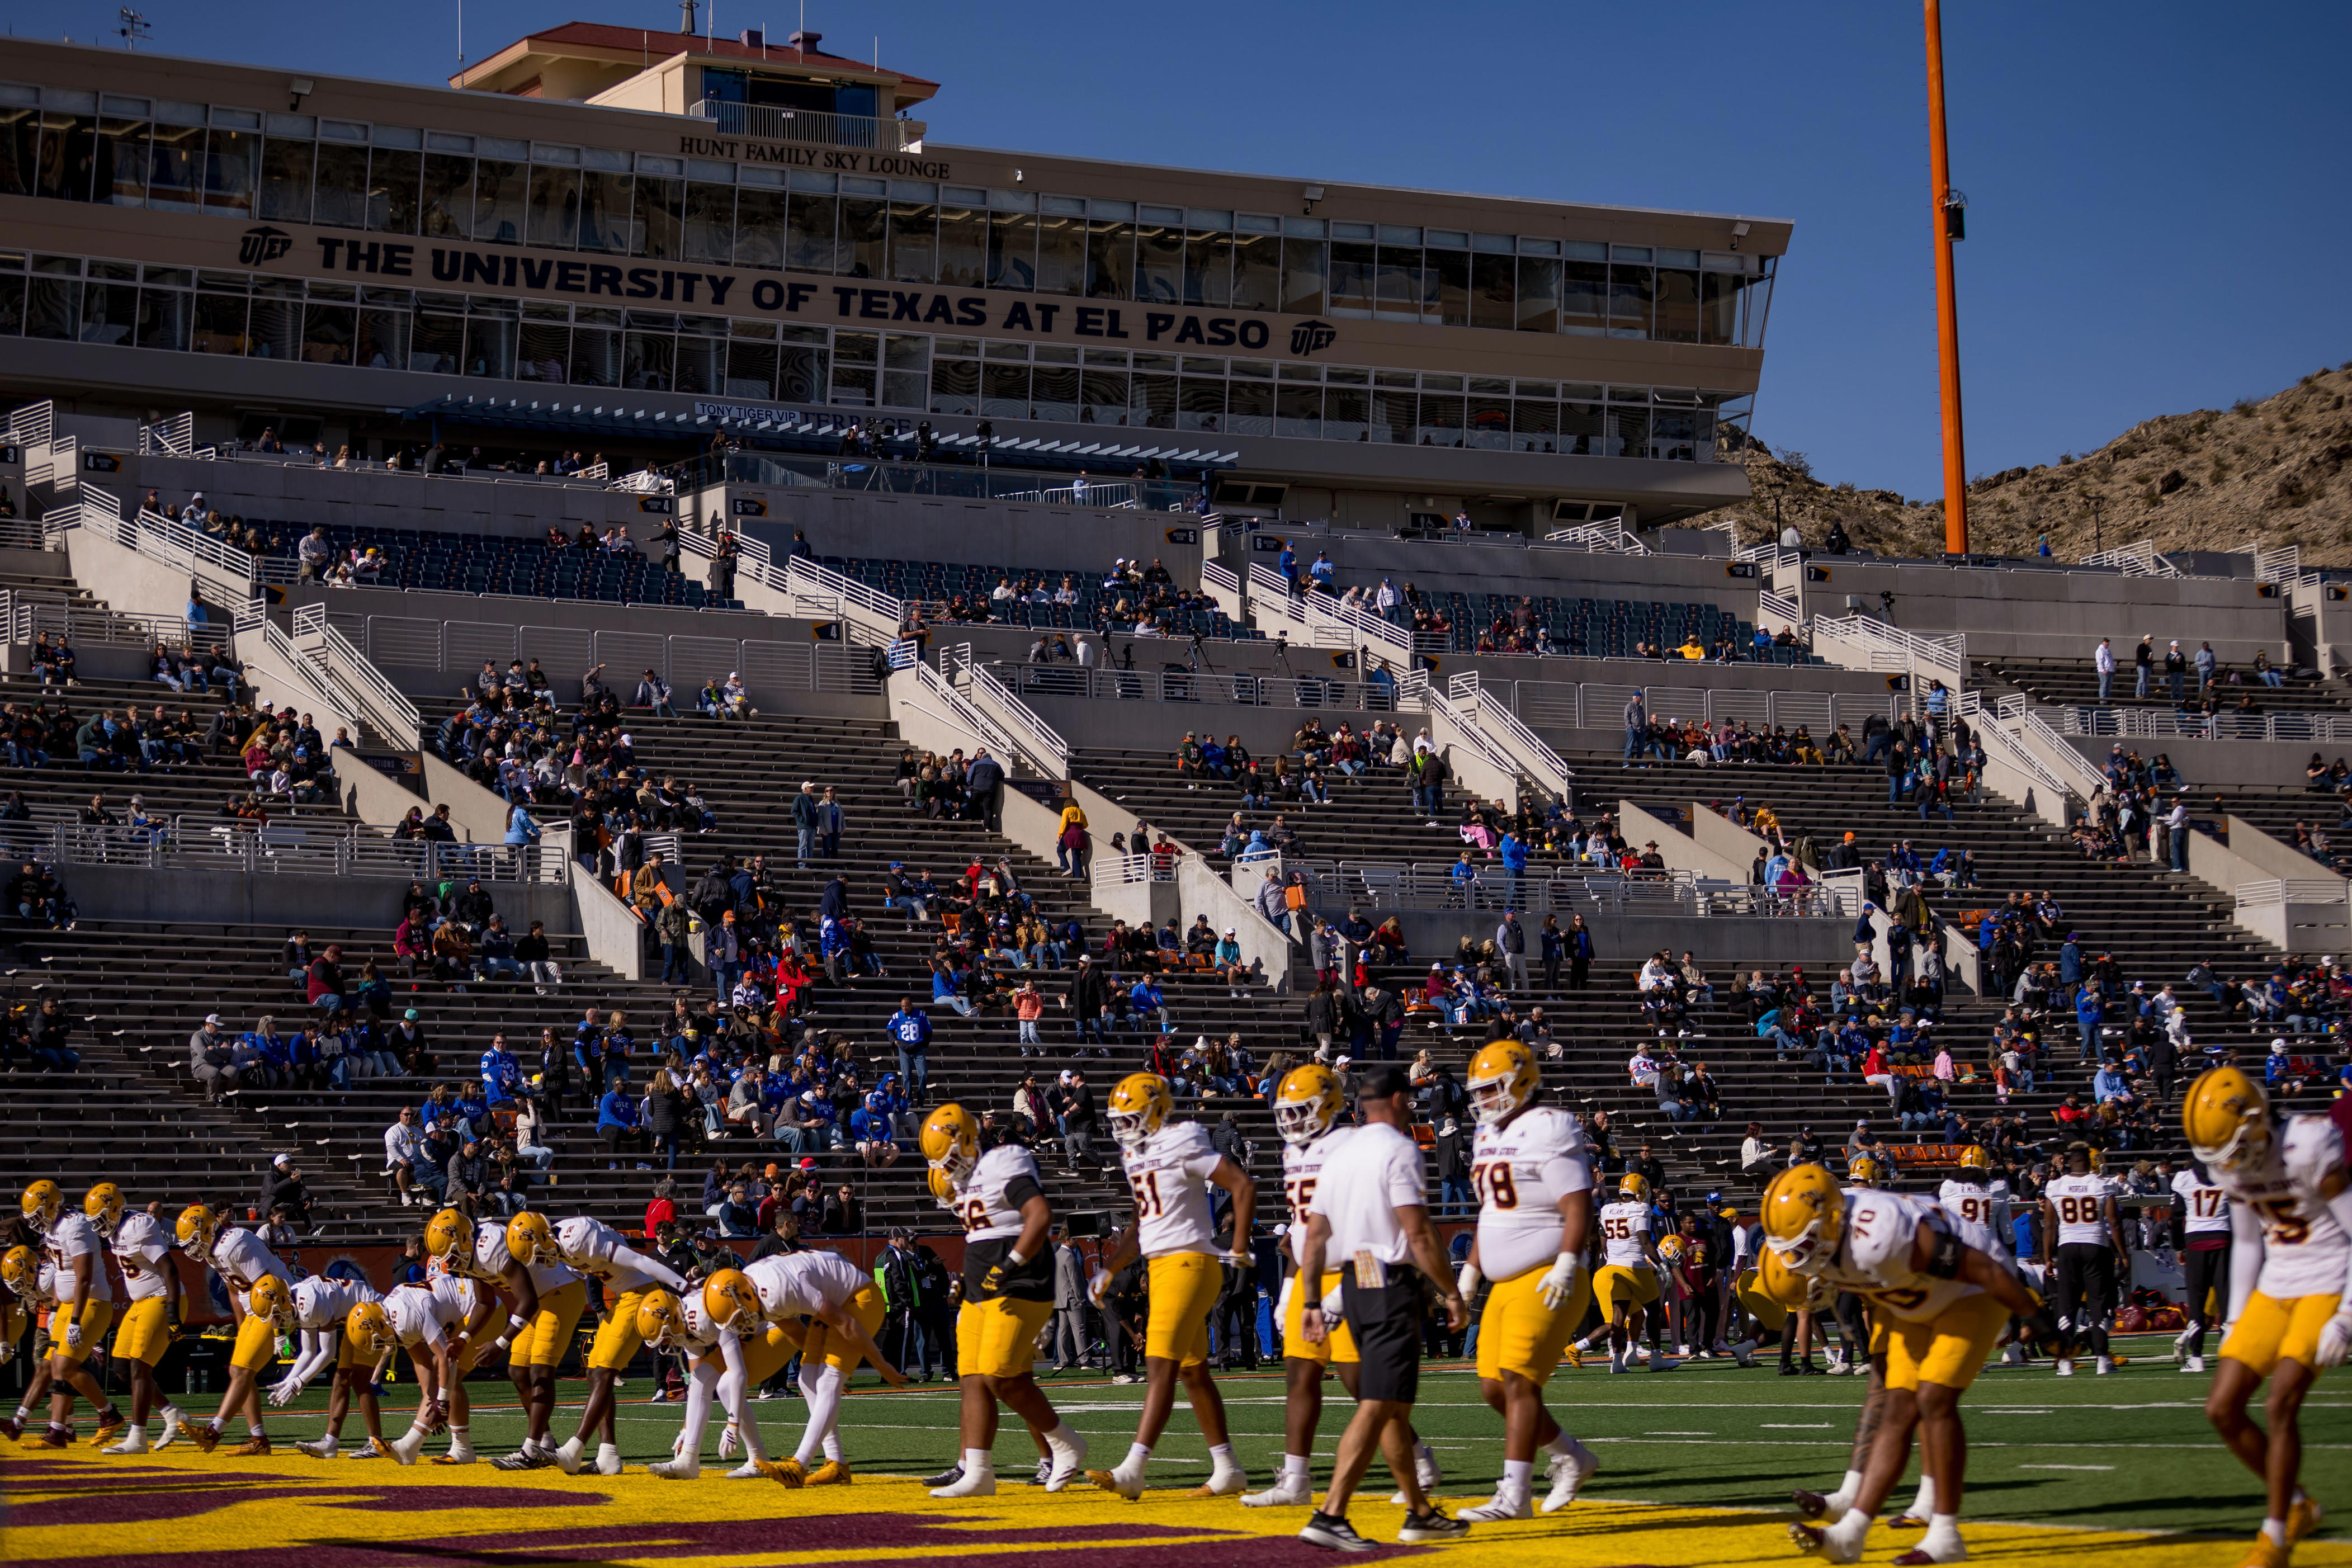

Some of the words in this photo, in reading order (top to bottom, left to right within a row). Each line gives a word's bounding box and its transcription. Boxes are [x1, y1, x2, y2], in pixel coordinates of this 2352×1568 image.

[680, 136, 738, 159] HUNT
[745, 143, 818, 166] FAMILY
[824, 152, 861, 172] SKY
[868, 156, 950, 180] LOUNGE
[239, 226, 292, 266] UTEP
[317, 237, 414, 276] THE
[432, 248, 735, 305] UNIVERSITY
[752, 279, 818, 312] OF
[833, 286, 986, 327] TEXAS
[1003, 301, 1060, 332] AT
[1075, 306, 1128, 338] EL
[1146, 312, 1269, 349] PASO
[1290, 320, 1336, 356] UTEP
[700, 403, 733, 417] TONY
[736, 407, 773, 421] TIGER
[780, 410, 796, 422] VIP
[800, 412, 911, 435] TERRCE
[7, 447, 15, 462] 3
[88, 455, 94, 469] 4
[664, 499, 669, 512] 4
[736, 500, 742, 513] 5
[1189, 531, 1194, 542] 5
[1256, 537, 1262, 549] 6
[1748, 565, 1753, 577] 6
[1810, 568, 1815, 580] 7
[2270, 585, 2276, 597] 7
[830, 625, 837, 639] 4
[1347, 654, 1353, 667] 5
[1417, 656, 1423, 670] 6
[1901, 676, 1907, 689] 6
[367, 759, 395, 769] SECTIONS
[1022, 784, 1046, 794] SECTIONS
[900, 1024, 920, 1041] 28
[1147, 1159, 1161, 1168] STATE
[1472, 1162, 1517, 1208] 78
[1130, 1172, 1161, 1217] 51
[2062, 1197, 2097, 1223] 88
[2193, 1189, 2223, 1217] 17
[1962, 1198, 1991, 1225] 91
[1605, 1218, 1630, 1240] 55
